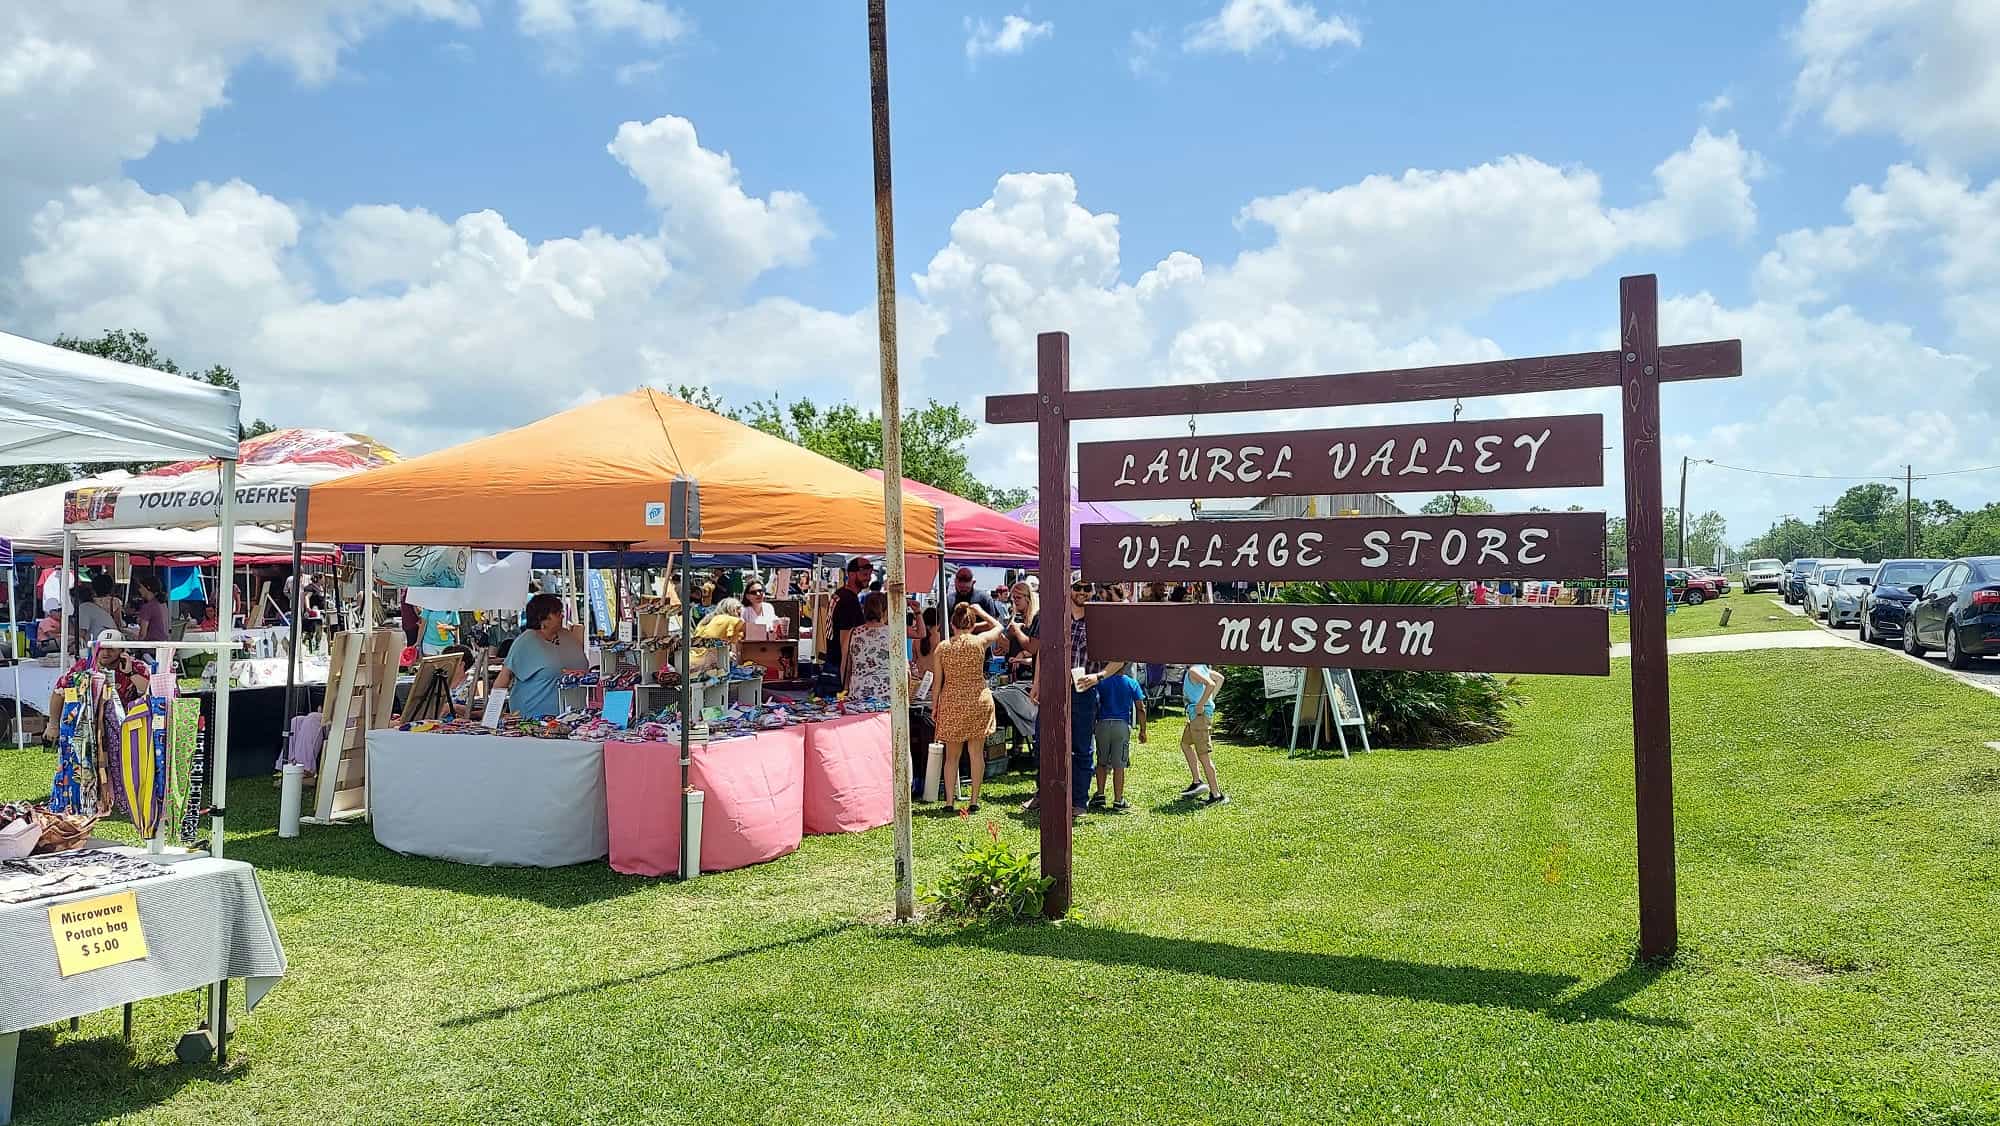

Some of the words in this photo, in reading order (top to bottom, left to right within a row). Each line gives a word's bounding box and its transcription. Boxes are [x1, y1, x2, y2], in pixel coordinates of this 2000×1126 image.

[1114, 445, 1292, 488] LAUREL
[1328, 428, 1552, 481] VALLEY
[139, 491, 187, 509] YOUR
[234, 486, 297, 504] REFRES
[1118, 532, 1324, 570] VILLAGE
[1360, 528, 1549, 568] STORE
[1600, 579, 1628, 588] FESTI
[1217, 617, 1435, 656] MUSEUM
[61, 905, 123, 925] Microwave
[65, 926, 104, 942] Potato
[105, 921, 128, 932] bag
[81, 944, 90, 957] $
[94, 938, 119, 954] 5.00
